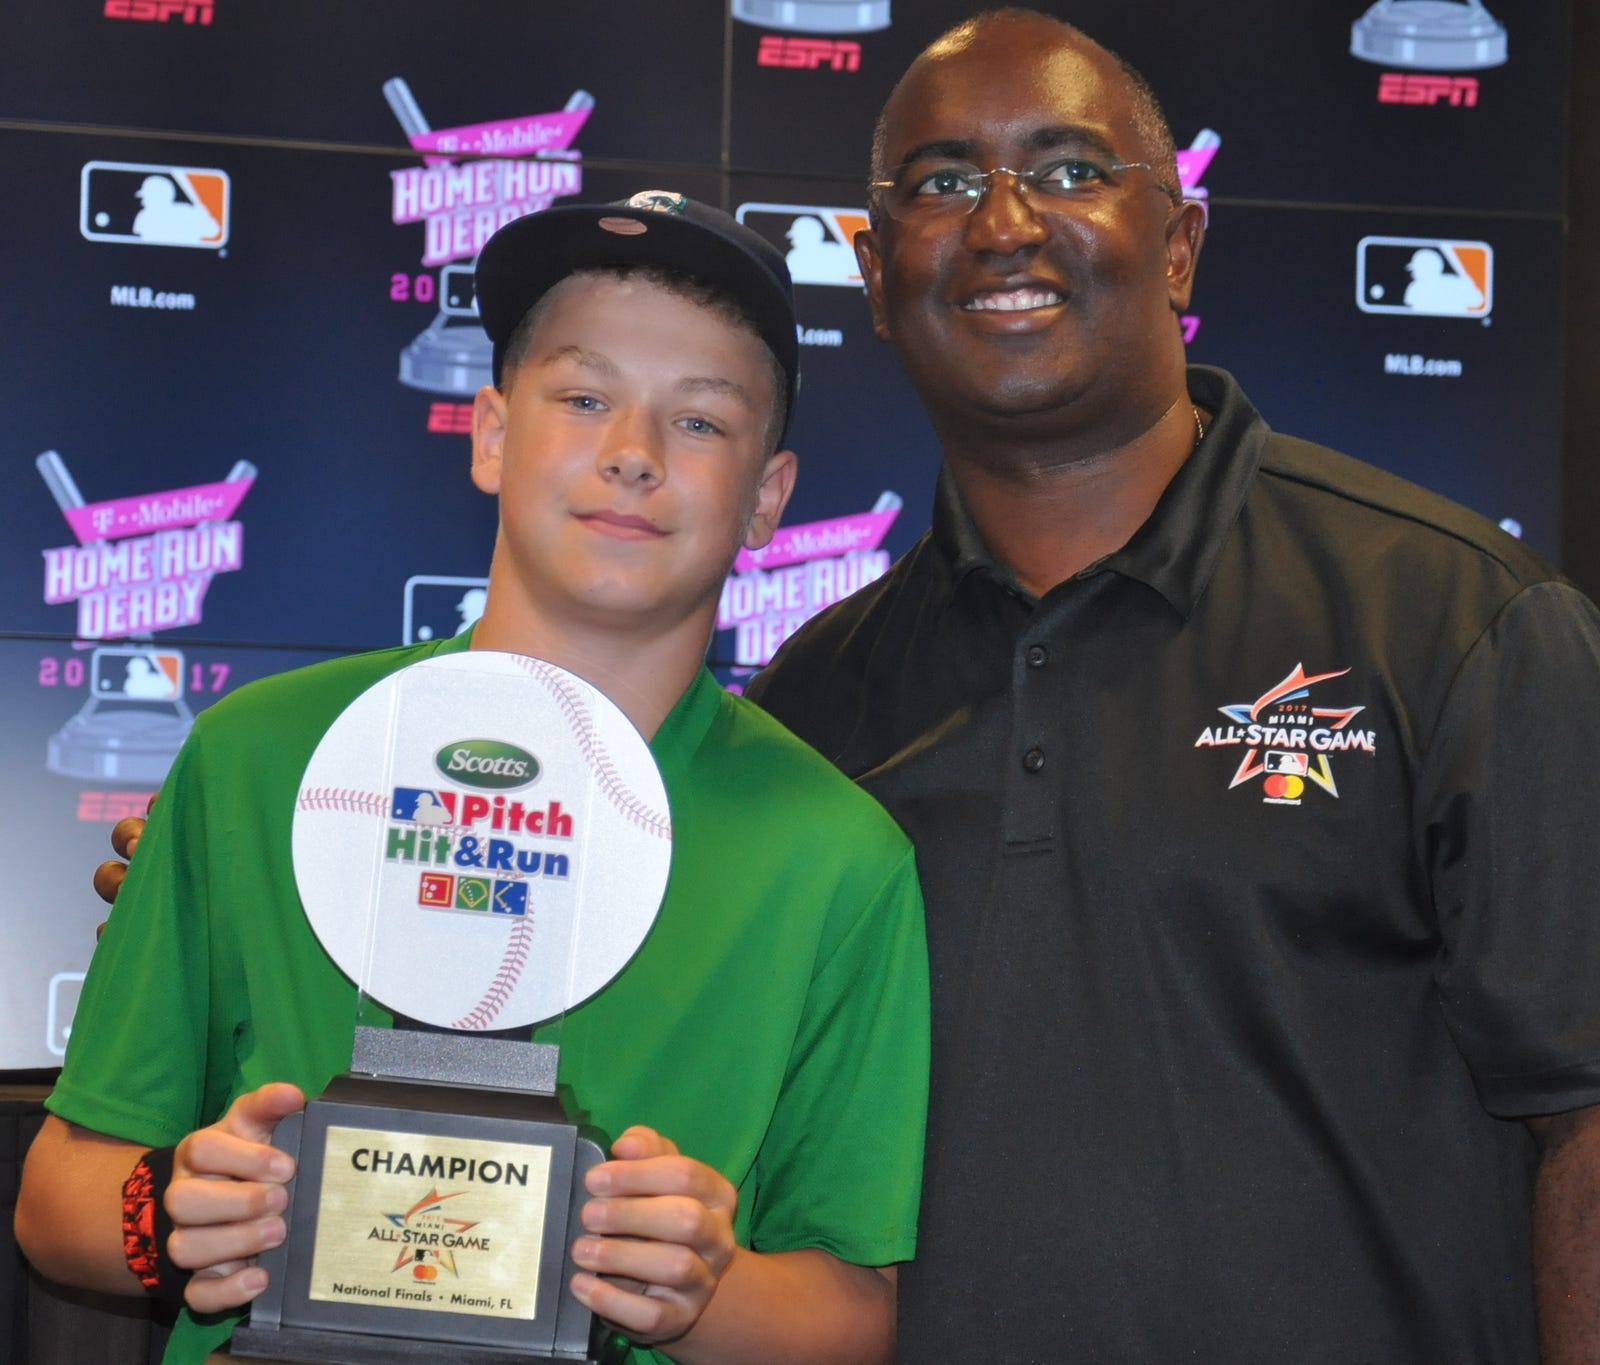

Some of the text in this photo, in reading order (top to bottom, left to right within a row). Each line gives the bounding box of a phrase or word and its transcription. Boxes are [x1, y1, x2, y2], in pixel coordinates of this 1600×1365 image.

[103, 0, 215, 25] ESPN
[757, 35, 862, 72] ESPN
[1377, 73, 1479, 107] ESPN
[392, 162, 495, 221] HOME
[110, 285, 196, 310] MLB.com
[390, 272, 435, 302] 20
[1384, 353, 1462, 377] MLB.com
[47, 526, 240, 599] HOME RUN
[79, 579, 203, 639] DERBY
[38, 657, 231, 692] 20 17
[1268, 714, 1314, 726] MIAMI
[1278, 704, 1308, 713] 2017
[1194, 724, 1376, 752] ALL STAR GAME
[446, 748, 528, 778] Scotts
[461, 794, 574, 838] Pitch
[351, 1147, 530, 1187] CHAMPION
[401, 1229, 440, 1247] STAR
[442, 1233, 491, 1252] GAME
[416, 1222, 445, 1231] MIAMI
[332, 1282, 513, 1311] National Finals Miami, FL
